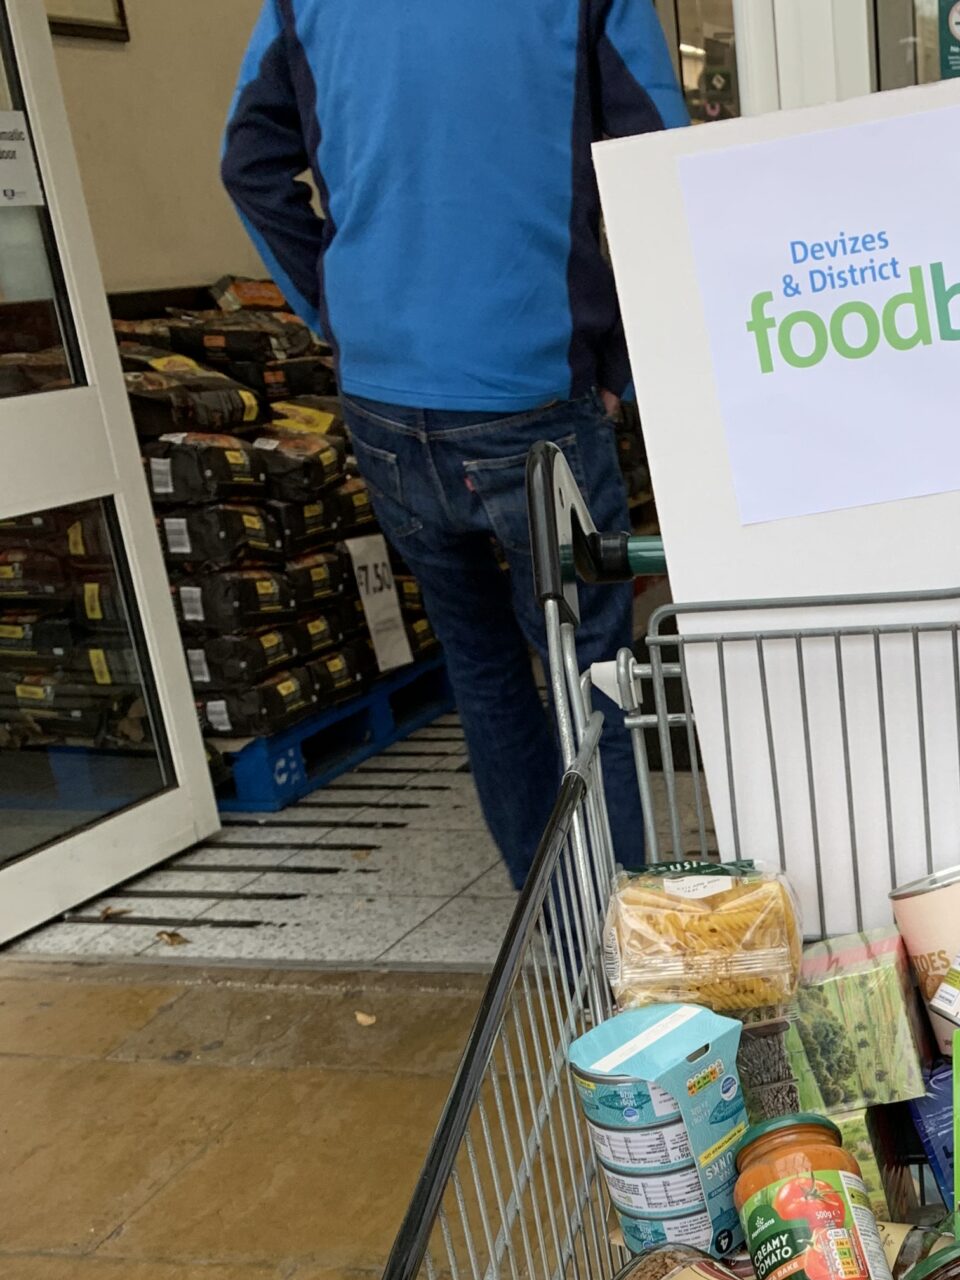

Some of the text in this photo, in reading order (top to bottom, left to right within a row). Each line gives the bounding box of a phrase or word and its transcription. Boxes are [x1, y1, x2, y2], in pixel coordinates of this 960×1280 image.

[790, 230, 889, 264] Devizes
[782, 257, 901, 298] & District
[912, 950, 950, 973] TOES
[754, 1233, 789, 1267] CREAMY
[757, 1246, 793, 1280] TOMATO
